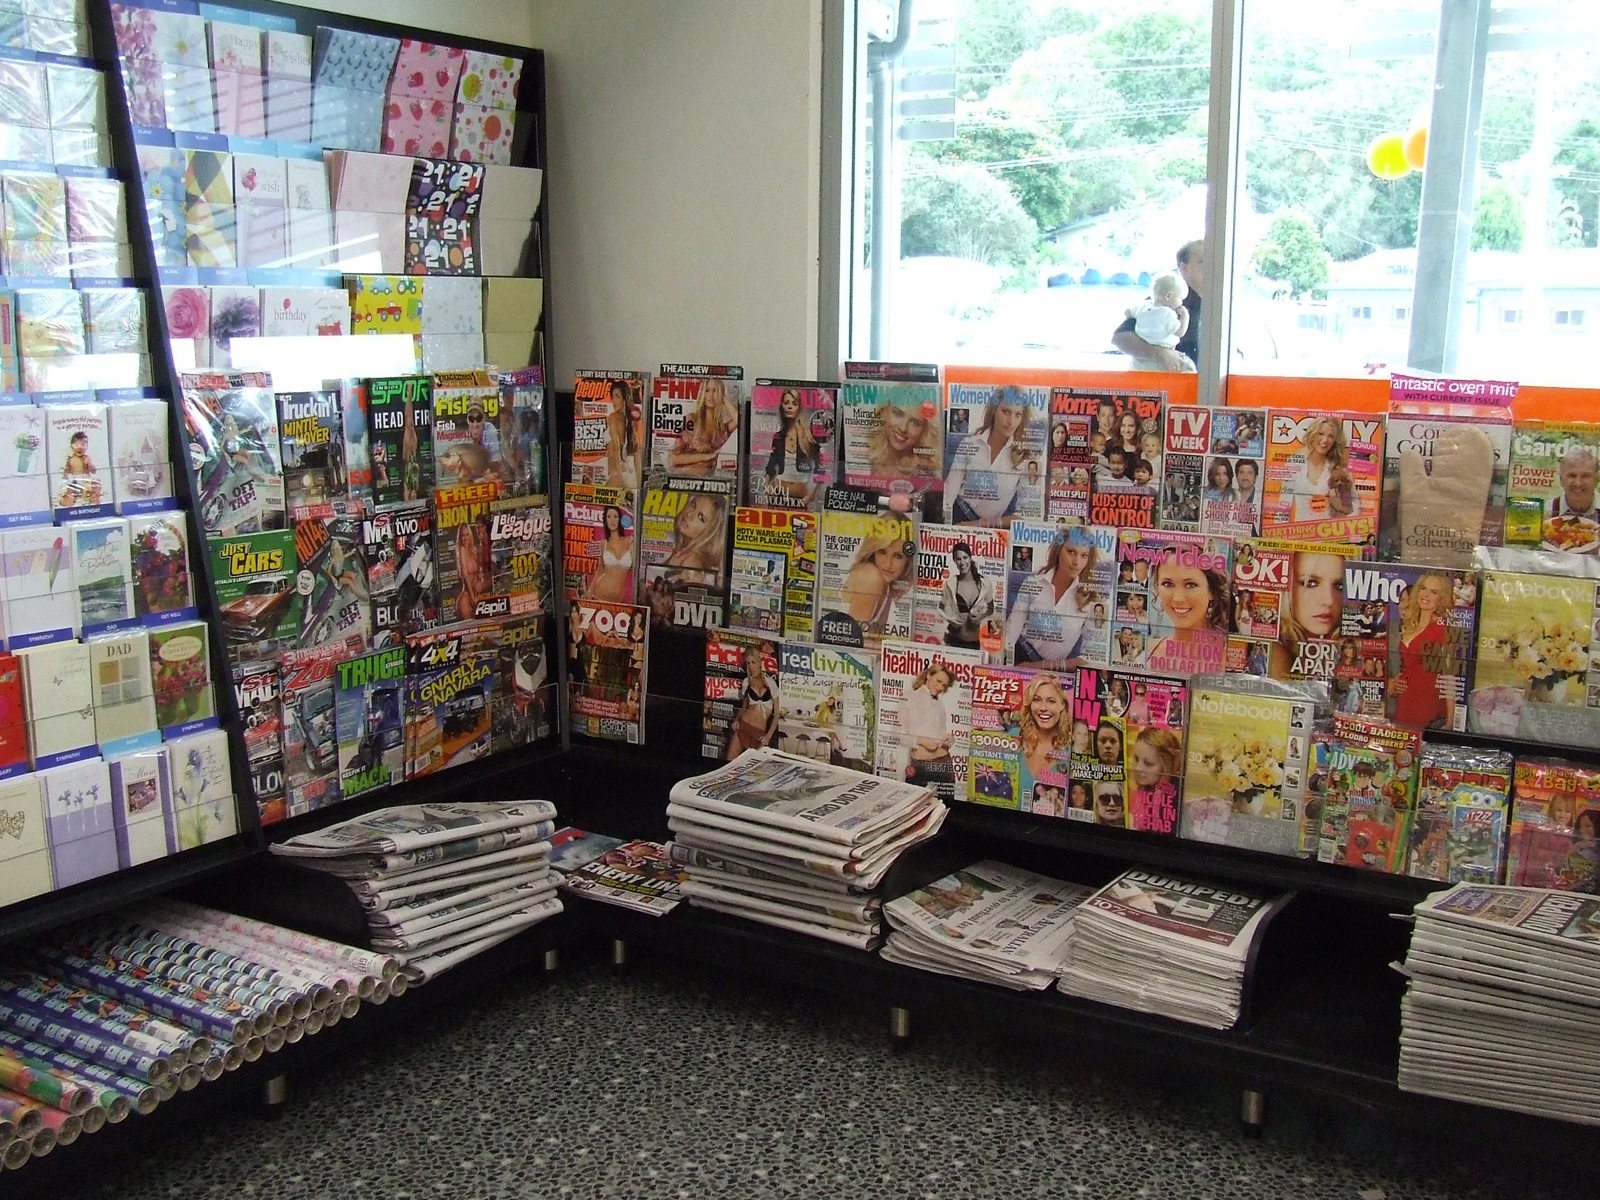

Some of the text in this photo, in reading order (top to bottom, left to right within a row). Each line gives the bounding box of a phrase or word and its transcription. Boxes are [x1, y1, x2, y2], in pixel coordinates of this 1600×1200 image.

[458, 163, 484, 189] 21
[427, 191, 455, 212] 21
[443, 217, 469, 242] 21
[273, 308, 308, 323] birthday
[662, 365, 709, 374] THE ALL-NEW
[576, 379, 612, 401] people
[844, 384, 878, 406] new
[1448, 382, 1485, 395] oven
[654, 399, 682, 415] Lara
[1004, 388, 1047, 412] Weekly
[1404, 393, 1500, 406] WITH CURRENT ISSUE
[1128, 396, 1162, 420] Day
[374, 411, 404, 430] HEAD
[436, 420, 456, 432] Fish
[654, 414, 694, 434] Bingle
[1170, 412, 1208, 436] TV
[575, 424, 606, 440] BEST
[575, 438, 608, 450] BUMS!
[1170, 436, 1204, 450] WEEK
[1512, 464, 1556, 478] flower
[232, 479, 255, 498] OFF
[668, 478, 731, 493] UNCUT DVD!
[750, 475, 790, 497] Body
[1512, 477, 1554, 488] power
[441, 482, 495, 502] FREE!
[828, 490, 866, 502] FREE NAIL
[1050, 489, 1088, 500] SECRET SPLIT
[228, 490, 257, 511] TAP!
[756, 494, 806, 508] REVOLUTION
[827, 499, 857, 510] POLISH
[1092, 494, 1155, 510] KIDS OUT OF
[500, 514, 516, 526] Big
[1092, 507, 1154, 528] CONTROL
[396, 518, 418, 536] two
[491, 516, 552, 540] League
[565, 526, 594, 541] PRIME
[736, 527, 754, 536] HDTV
[1317, 518, 1375, 538] GUYS!
[736, 534, 792, 546] CATCH PLASMAS
[824, 534, 862, 545] THE GREAT
[1013, 522, 1114, 552] Women's Weekly
[1258, 540, 1280, 548] FREE!
[220, 542, 252, 558] JUST
[565, 540, 588, 556] TIME
[826, 542, 856, 552] SEX DIET
[966, 534, 1006, 559] Health
[231, 550, 283, 576] CARS
[918, 552, 949, 568] TOTAL
[1120, 542, 1227, 572] New Idea
[511, 553, 539, 579] 100
[917, 566, 946, 580] BODY
[1236, 557, 1289, 584] OK!
[1345, 568, 1406, 604] Who
[476, 598, 508, 616] Rapid
[1446, 608, 1473, 620] Nicole
[674, 601, 723, 630] DVD
[822, 620, 853, 635] FREE!
[821, 633, 861, 645] napoleon
[106, 642, 132, 658] DAD
[1165, 640, 1220, 660] BILLION
[882, 647, 922, 677] health
[1150, 656, 1197, 672] DOLLAR
[420, 658, 478, 700] GNARLY
[432, 664, 492, 706] NAVARA
[882, 678, 904, 688] NAOMI
[974, 675, 1019, 692] That's
[1080, 668, 1098, 700] N
[1361, 680, 1385, 689] INSIDE
[882, 686, 904, 697] WATTS
[973, 690, 1007, 704] Life!
[1363, 693, 1382, 702] CULT
[1366, 688, 1379, 696] THE
[951, 713, 960, 724] 10
[951, 729, 970, 739] LOVE
[1342, 722, 1409, 740] COOL BADGES
[972, 734, 1019, 751] $30,000
[973, 749, 1018, 761] INSTANT WIN
[1070, 760, 1122, 774] STARS WITHOUT
[1072, 769, 1104, 780] MAKE-UP
[344, 764, 392, 798] MACK
[852, 778, 880, 800] THIS
[581, 862, 646, 884] ENEMY
[1127, 870, 1260, 908] DUMPED!
